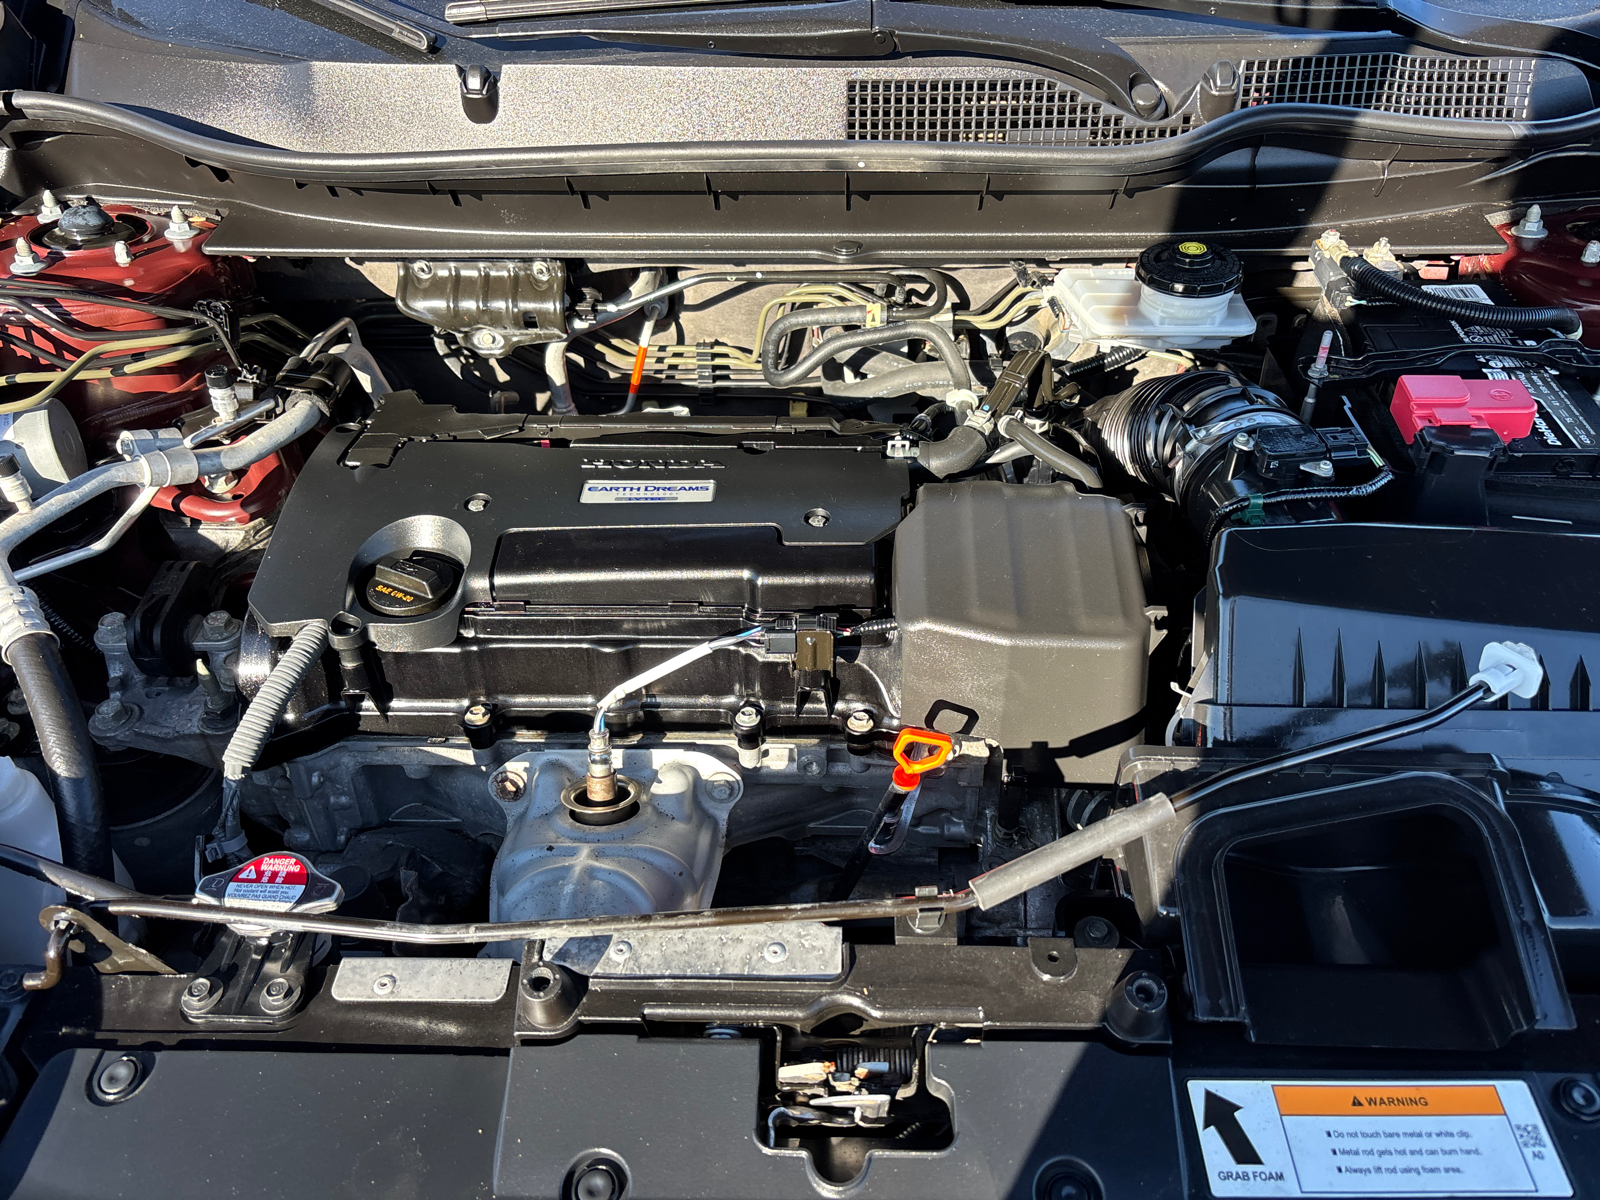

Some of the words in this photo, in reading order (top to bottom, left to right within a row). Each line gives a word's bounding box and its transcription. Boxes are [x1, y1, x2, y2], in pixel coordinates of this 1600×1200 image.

[581, 458, 726, 469] HONDA
[375, 585, 393, 594] SAE
[263, 857, 296, 865] DANGER
[261, 864, 300, 872] WARNUNG
[1365, 1096, 1429, 1107] WARNING
[1333, 1130, 1345, 1138] Do
[1346, 1130, 1358, 1138] not
[1360, 1130, 1381, 1138] touch
[1383, 1130, 1401, 1138] bare
[1402, 1130, 1423, 1138] metal
[1434, 1130, 1455, 1138] white
[1456, 1130, 1472, 1140] clip.
[1338, 1148, 1360, 1156] Metal
[1362, 1148, 1375, 1156] rod
[1376, 1148, 1393, 1158] gets
[1395, 1148, 1407, 1156] hot
[1409, 1148, 1423, 1156] and
[1440, 1148, 1459, 1156] burn
[1460, 1147, 1483, 1156] hand.
[1217, 1170, 1250, 1181] GRAB
[1252, 1170, 1285, 1181] FOAM
[1344, 1165, 1372, 1176] Always
[1373, 1165, 1384, 1175] lift
[1385, 1165, 1398, 1175] rod
[1400, 1166, 1421, 1176] using
[1421, 1165, 1442, 1174] foam
